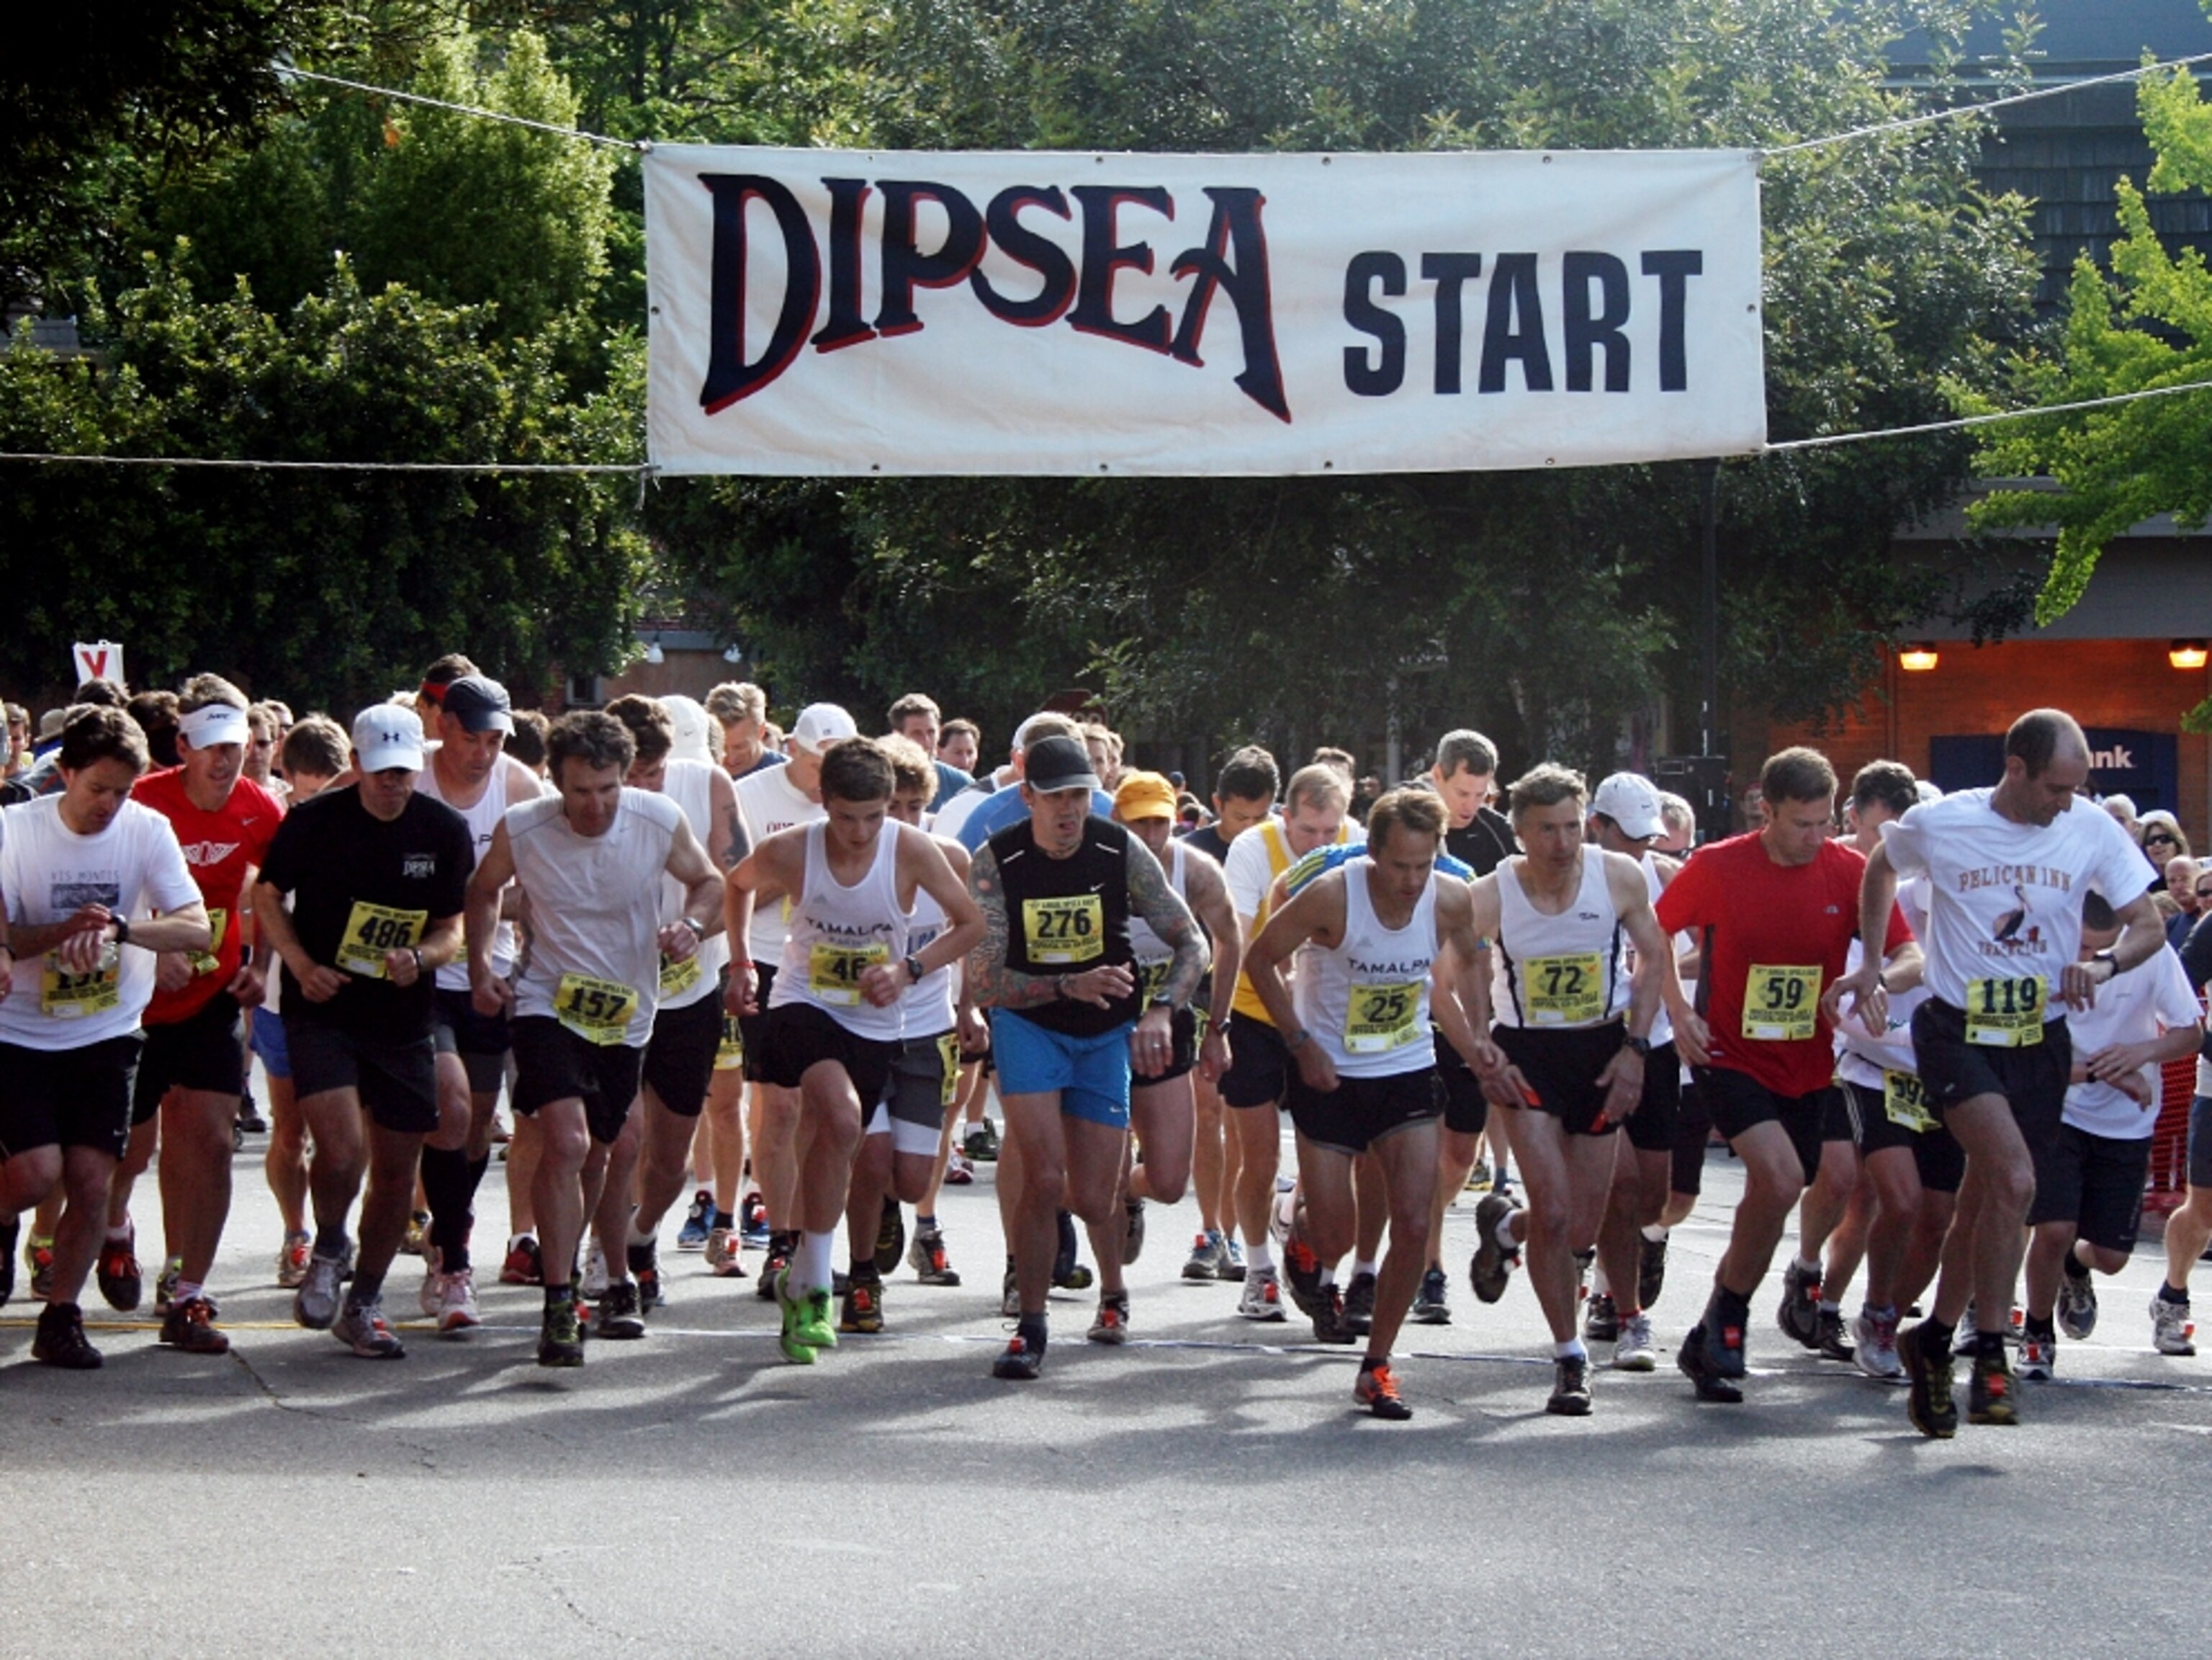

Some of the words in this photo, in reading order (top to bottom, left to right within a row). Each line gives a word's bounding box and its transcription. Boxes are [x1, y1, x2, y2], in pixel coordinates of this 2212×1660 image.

[697, 173, 1292, 423] DIPSEA
[1344, 250, 1702, 396] START
[1959, 866, 2036, 892] PELICAN
[2041, 867, 2071, 892] INN
[358, 916, 413, 948] 486
[806, 917, 893, 936] TAMALPA
[1037, 908, 1092, 938] 276
[1545, 966, 1581, 995] 72
[1766, 977, 1803, 1009] 59
[1982, 977, 2037, 1013] 119
[568, 987, 627, 1020] 157
[1369, 993, 1404, 1023] 25
